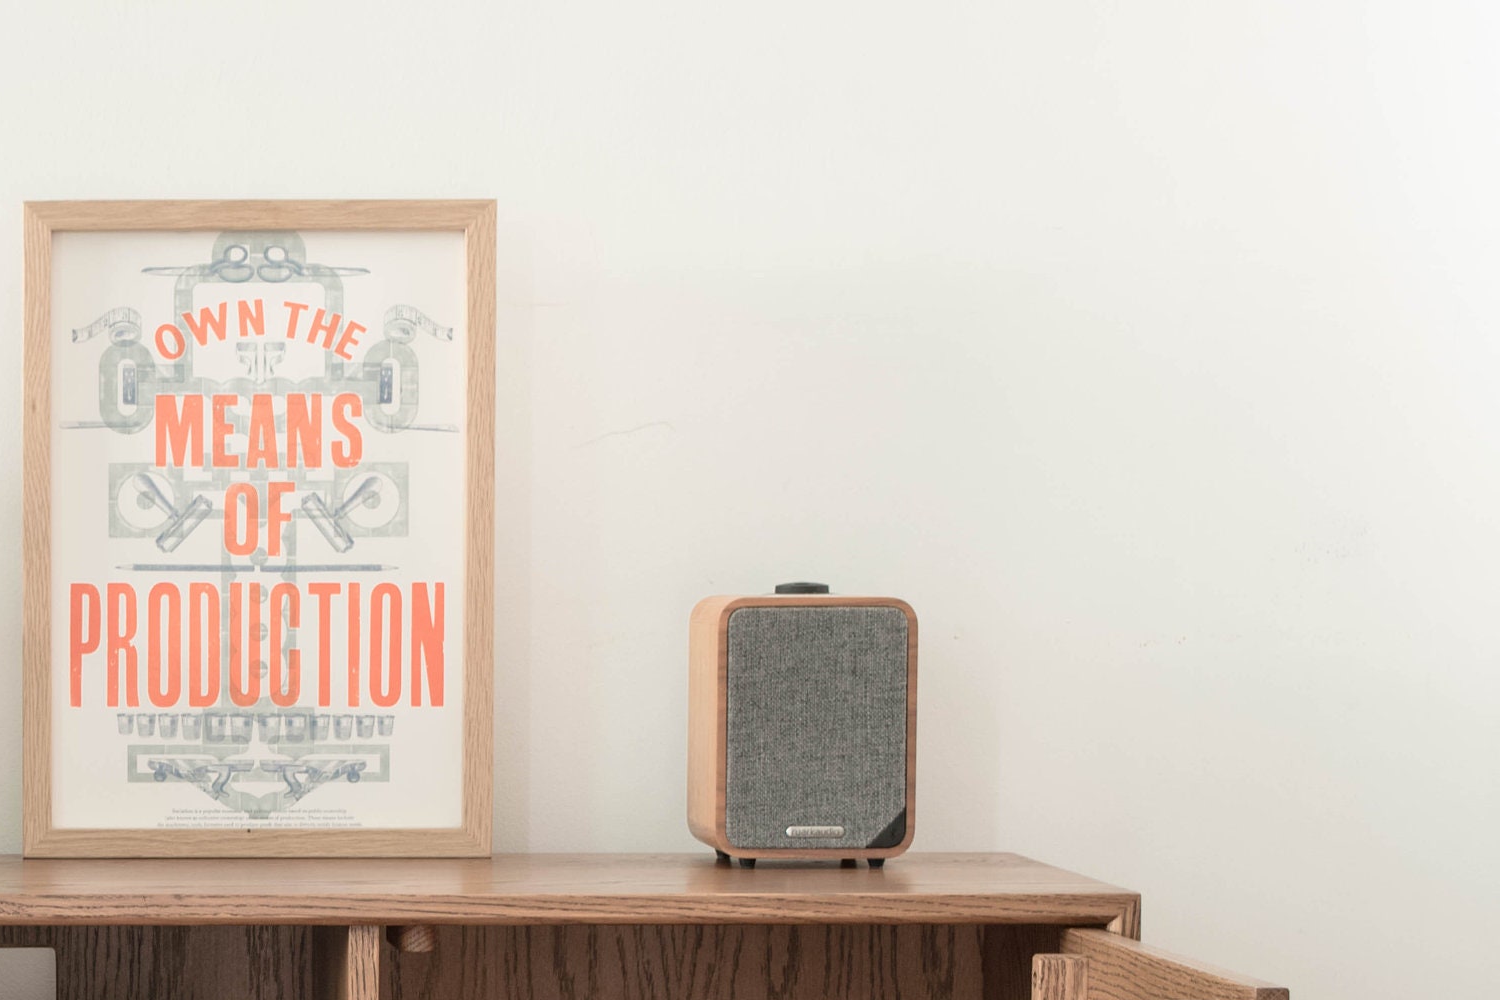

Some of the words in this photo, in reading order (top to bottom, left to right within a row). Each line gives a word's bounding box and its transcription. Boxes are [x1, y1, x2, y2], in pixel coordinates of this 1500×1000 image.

[154, 299, 265, 360] OWN
[283, 301, 368, 361] THE
[155, 393, 363, 469] MEANS
[223, 481, 296, 557] OF
[69, 581, 446, 708] PRODUCTION
